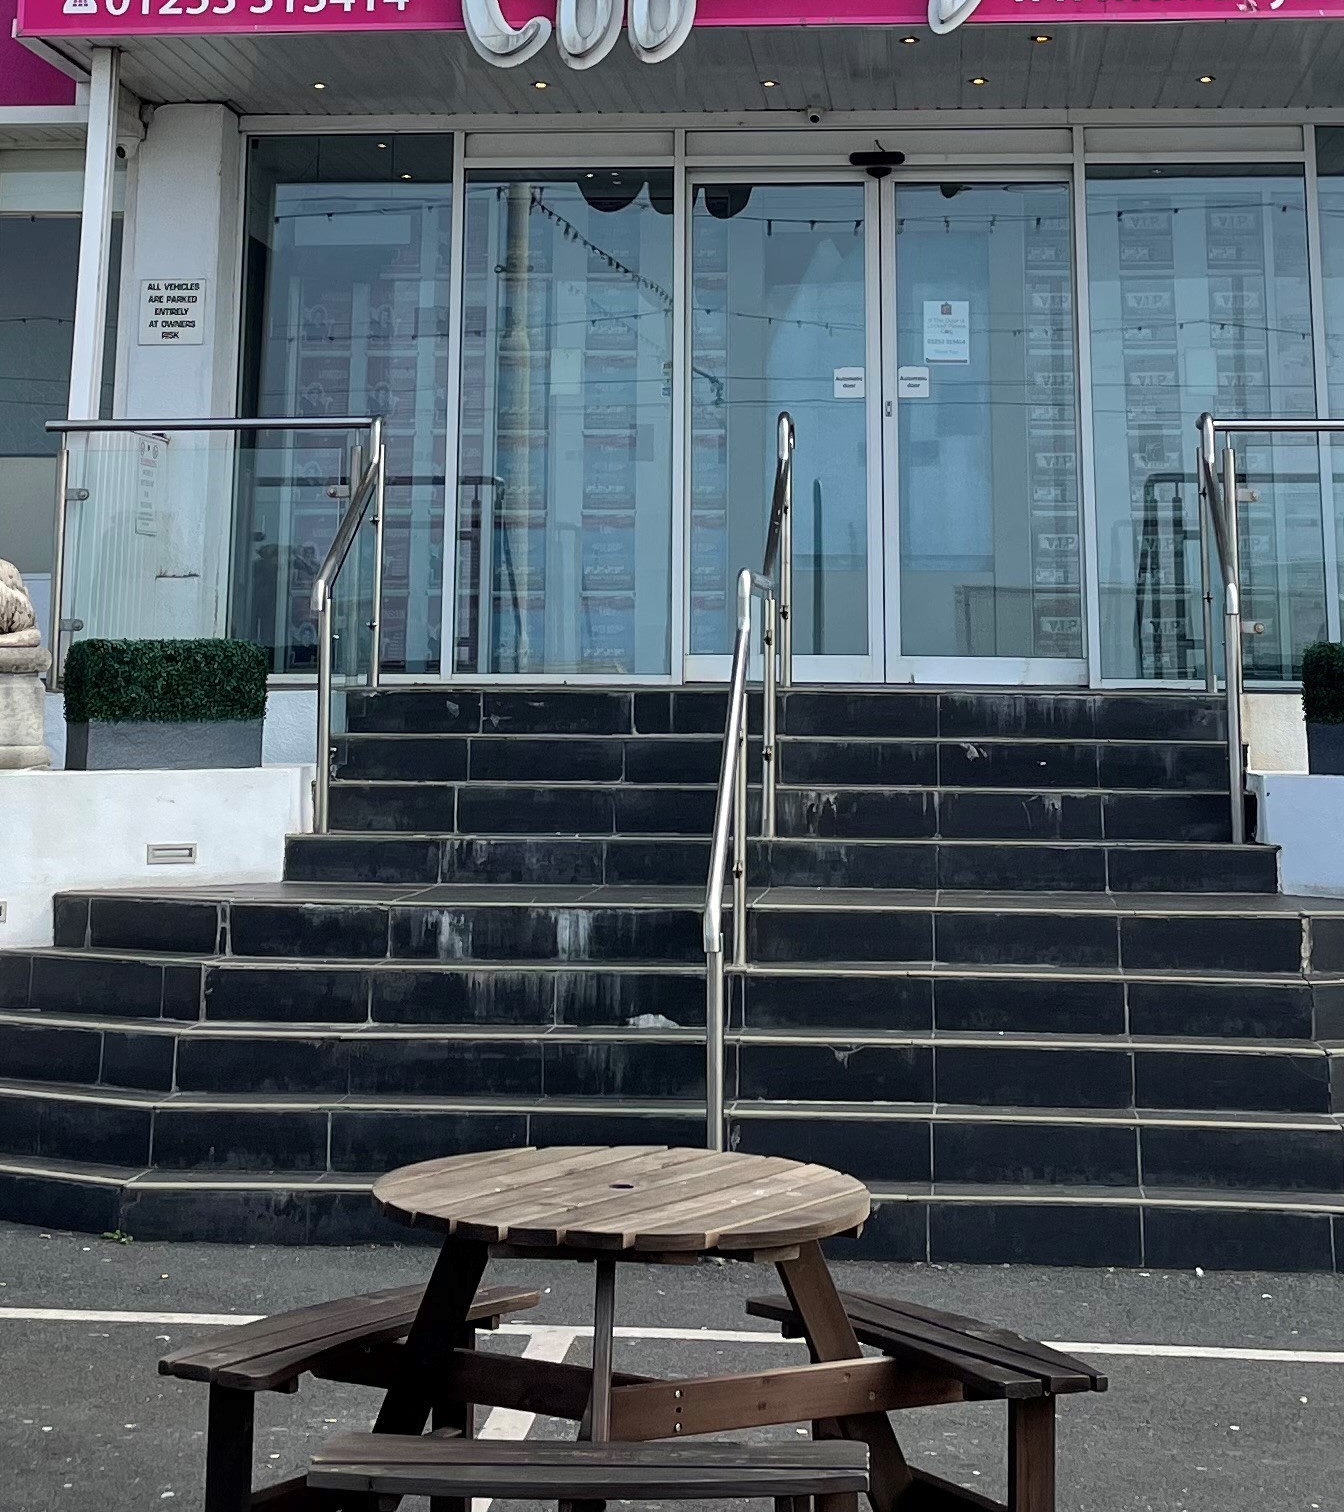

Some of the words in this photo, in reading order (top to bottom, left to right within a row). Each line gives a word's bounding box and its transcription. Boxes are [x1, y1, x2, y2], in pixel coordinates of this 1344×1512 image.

[147, 283, 161, 291] ALL
[164, 283, 200, 291] VEHICLES
[148, 295, 163, 303] ARE
[166, 295, 197, 303] PARKED
[154, 308, 189, 316] ENTIRELY
[148, 320, 158, 328] AT
[161, 320, 196, 328] OWNERS
[161, 331, 179, 339] RISK
